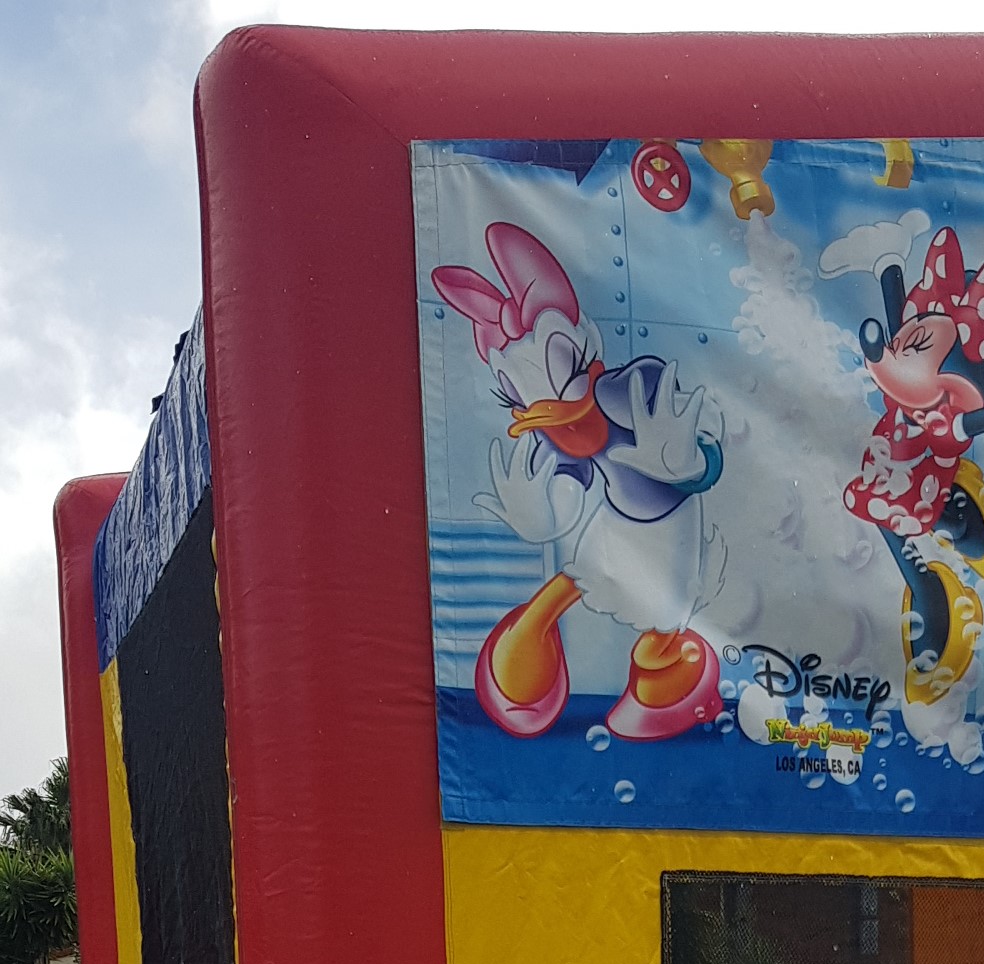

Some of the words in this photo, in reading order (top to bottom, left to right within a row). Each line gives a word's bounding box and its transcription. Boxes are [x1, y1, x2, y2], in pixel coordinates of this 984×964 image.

[775, 755, 796, 773] LOS
[799, 757, 847, 778] ANGELES,
[847, 760, 861, 776] CA
